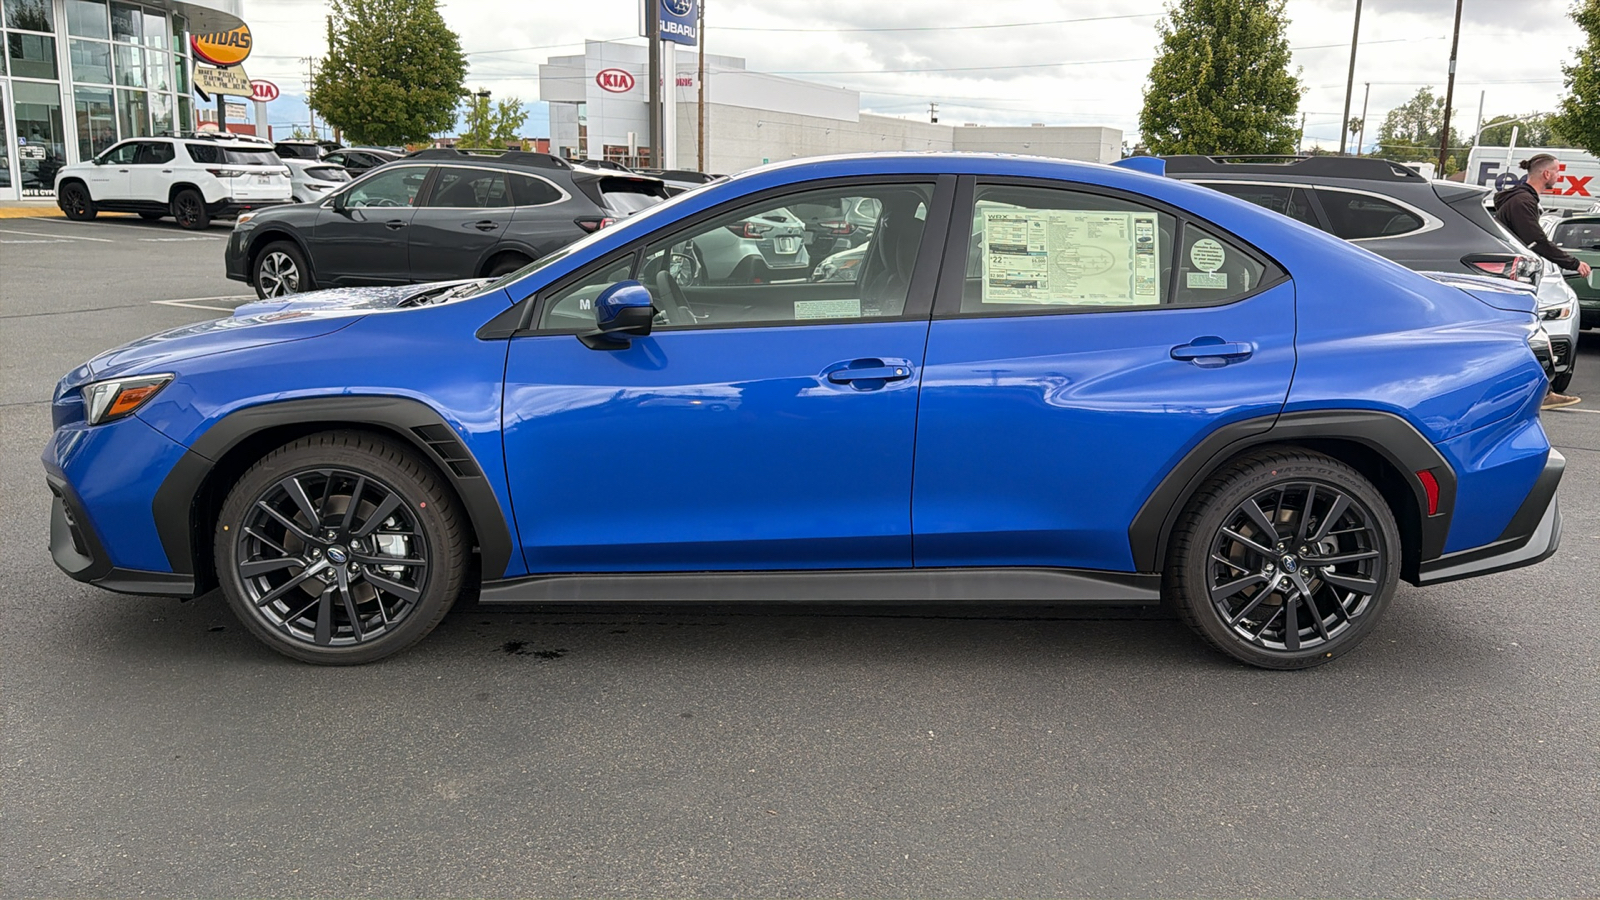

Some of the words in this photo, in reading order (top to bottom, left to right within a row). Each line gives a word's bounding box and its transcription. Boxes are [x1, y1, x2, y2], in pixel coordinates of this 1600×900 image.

[196, 31, 250, 49] MIDAS
[603, 73, 629, 88] KIA
[253, 84, 274, 97] KIA
[1477, 161, 1595, 197] Fex
[579, 298, 591, 310] M
[1230, 473, 1267, 497] SPORT
